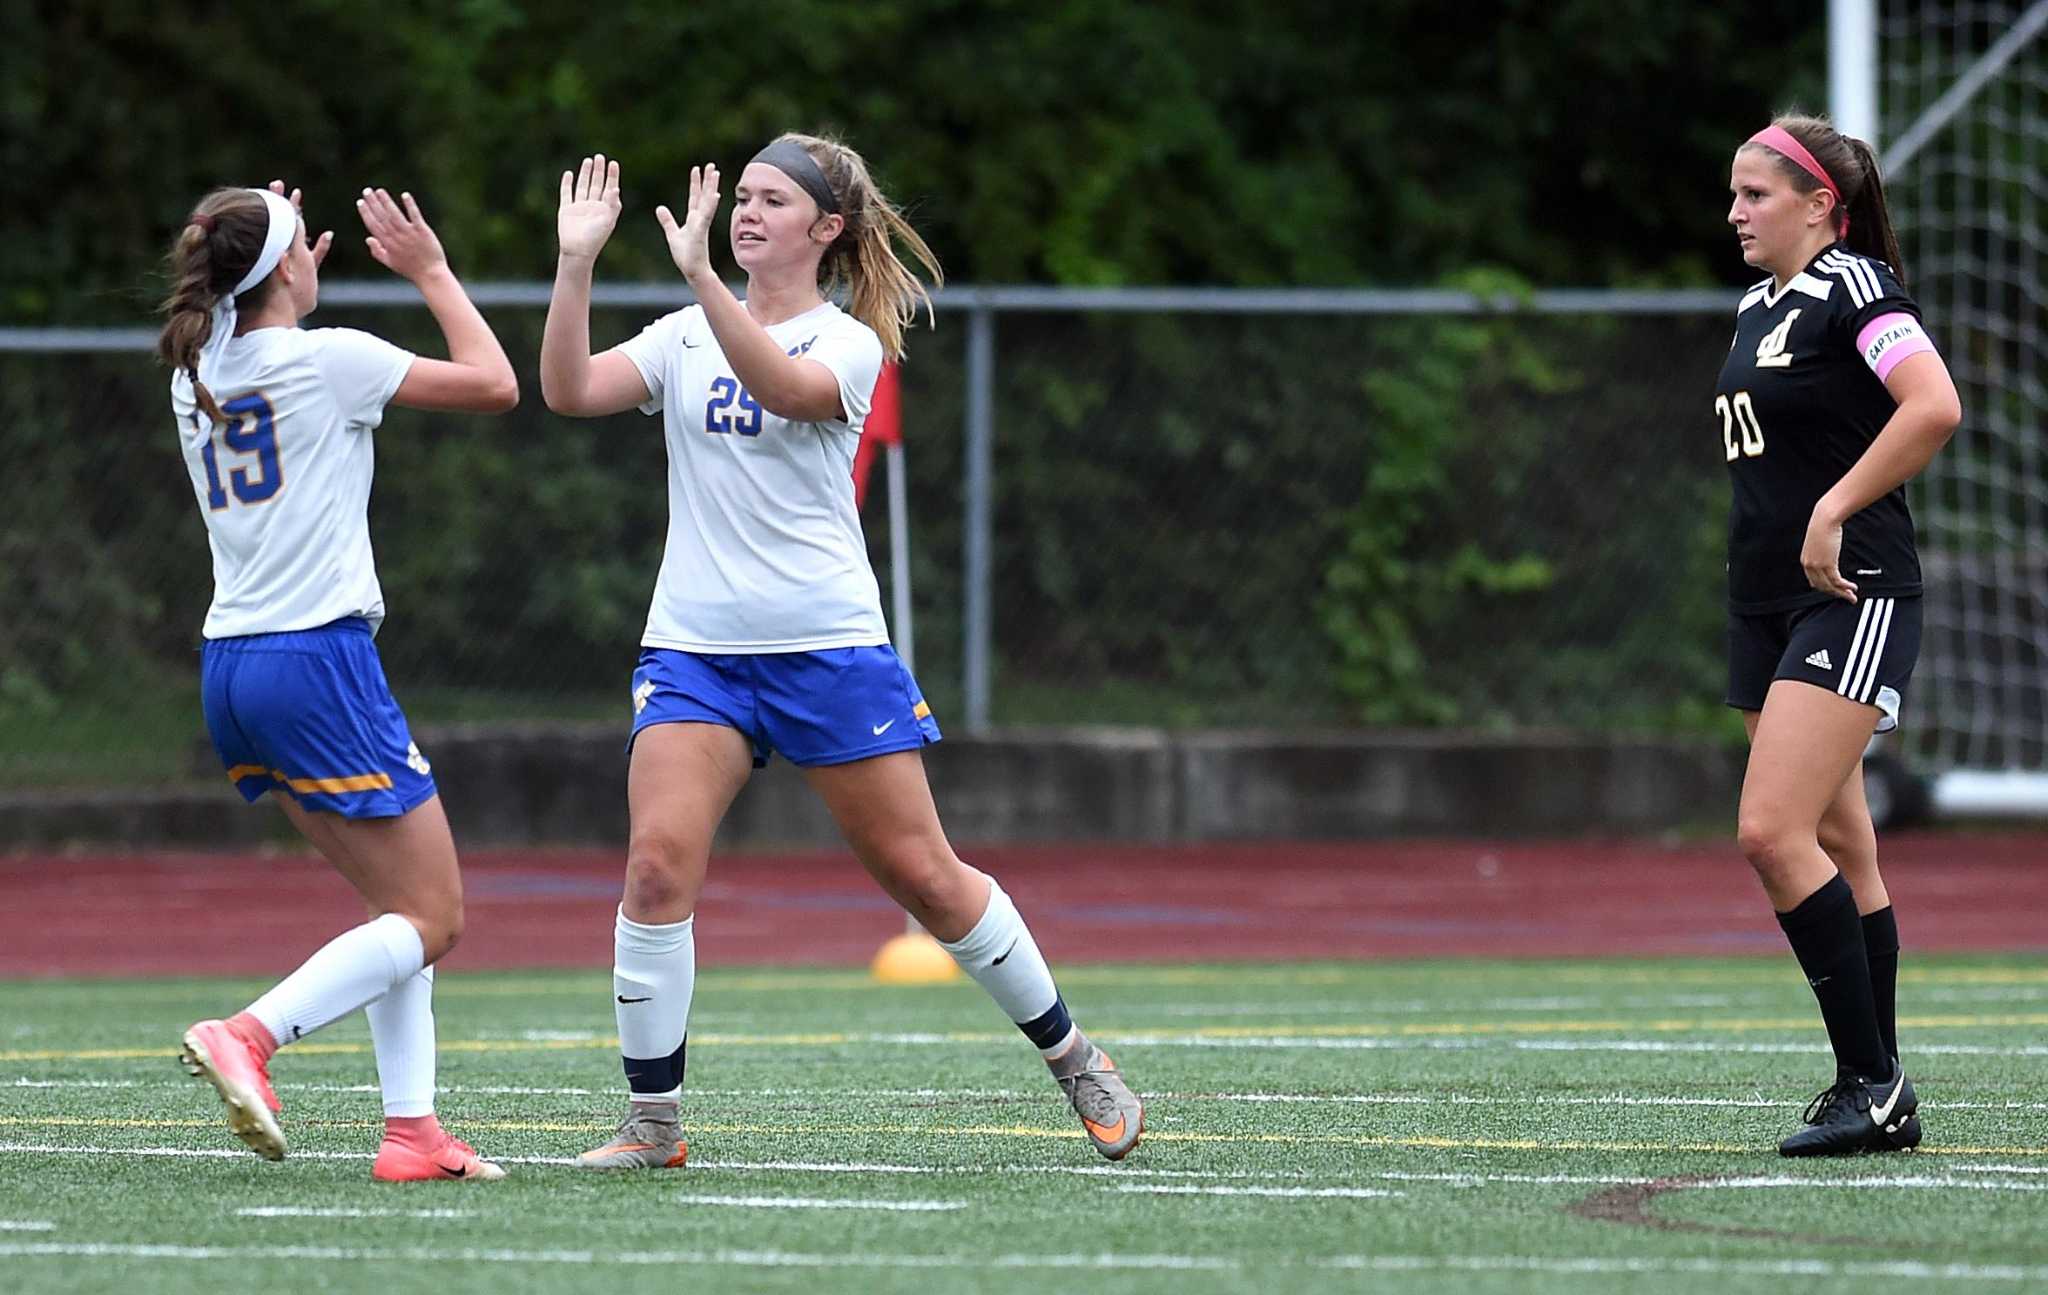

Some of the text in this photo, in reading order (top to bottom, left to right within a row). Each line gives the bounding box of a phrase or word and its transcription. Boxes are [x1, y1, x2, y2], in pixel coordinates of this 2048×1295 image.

[1869, 326, 1913, 361] CAPTAIN
[193, 391, 285, 511] 19
[1715, 390, 1765, 462] 20
